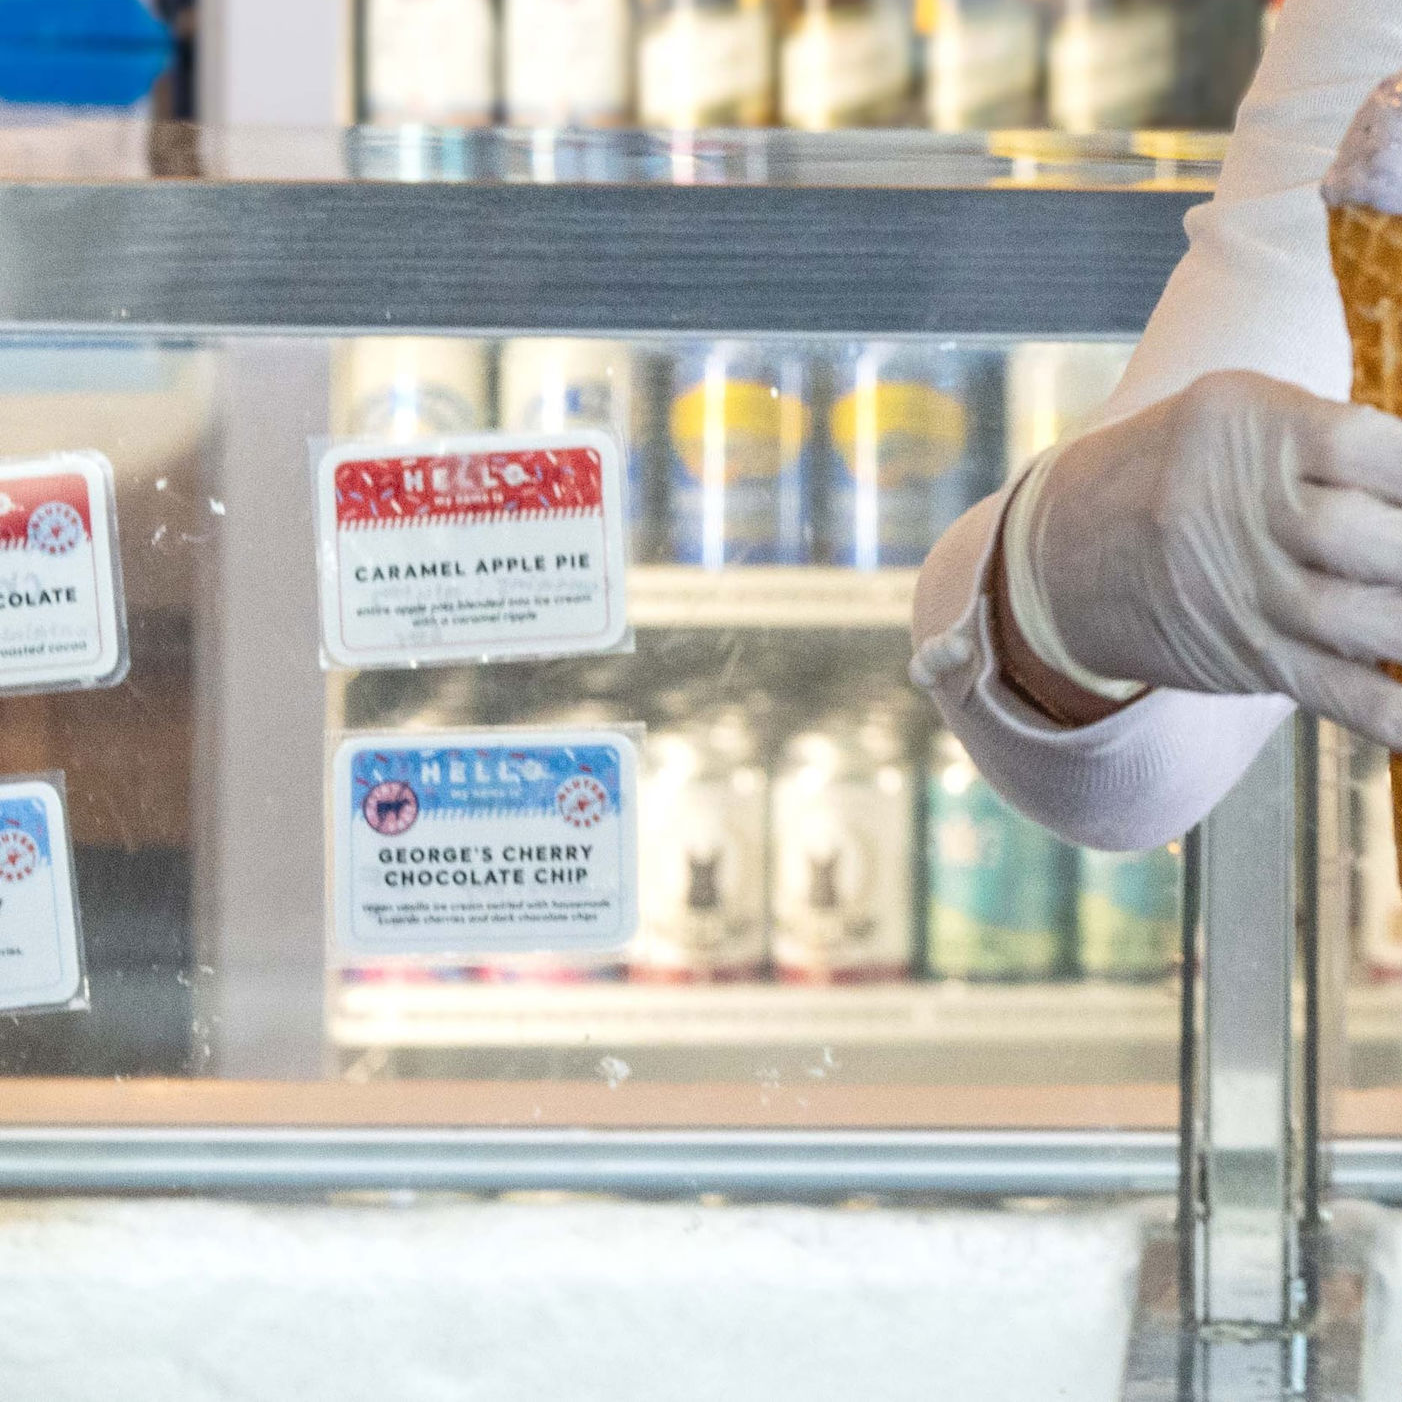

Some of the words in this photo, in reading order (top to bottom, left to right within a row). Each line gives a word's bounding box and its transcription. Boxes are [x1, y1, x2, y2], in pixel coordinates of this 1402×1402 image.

[403, 462, 527, 493] HELLO
[355, 561, 465, 583] CARAMEL
[475, 555, 547, 575] APPLE
[556, 552, 590, 570] PIE
[421, 759, 546, 785] HELLO
[379, 846, 493, 864] GEORGE'S
[503, 844, 594, 862] CHERRY
[384, 868, 524, 887] CHOCOLATE
[535, 867, 588, 885] CHIP
